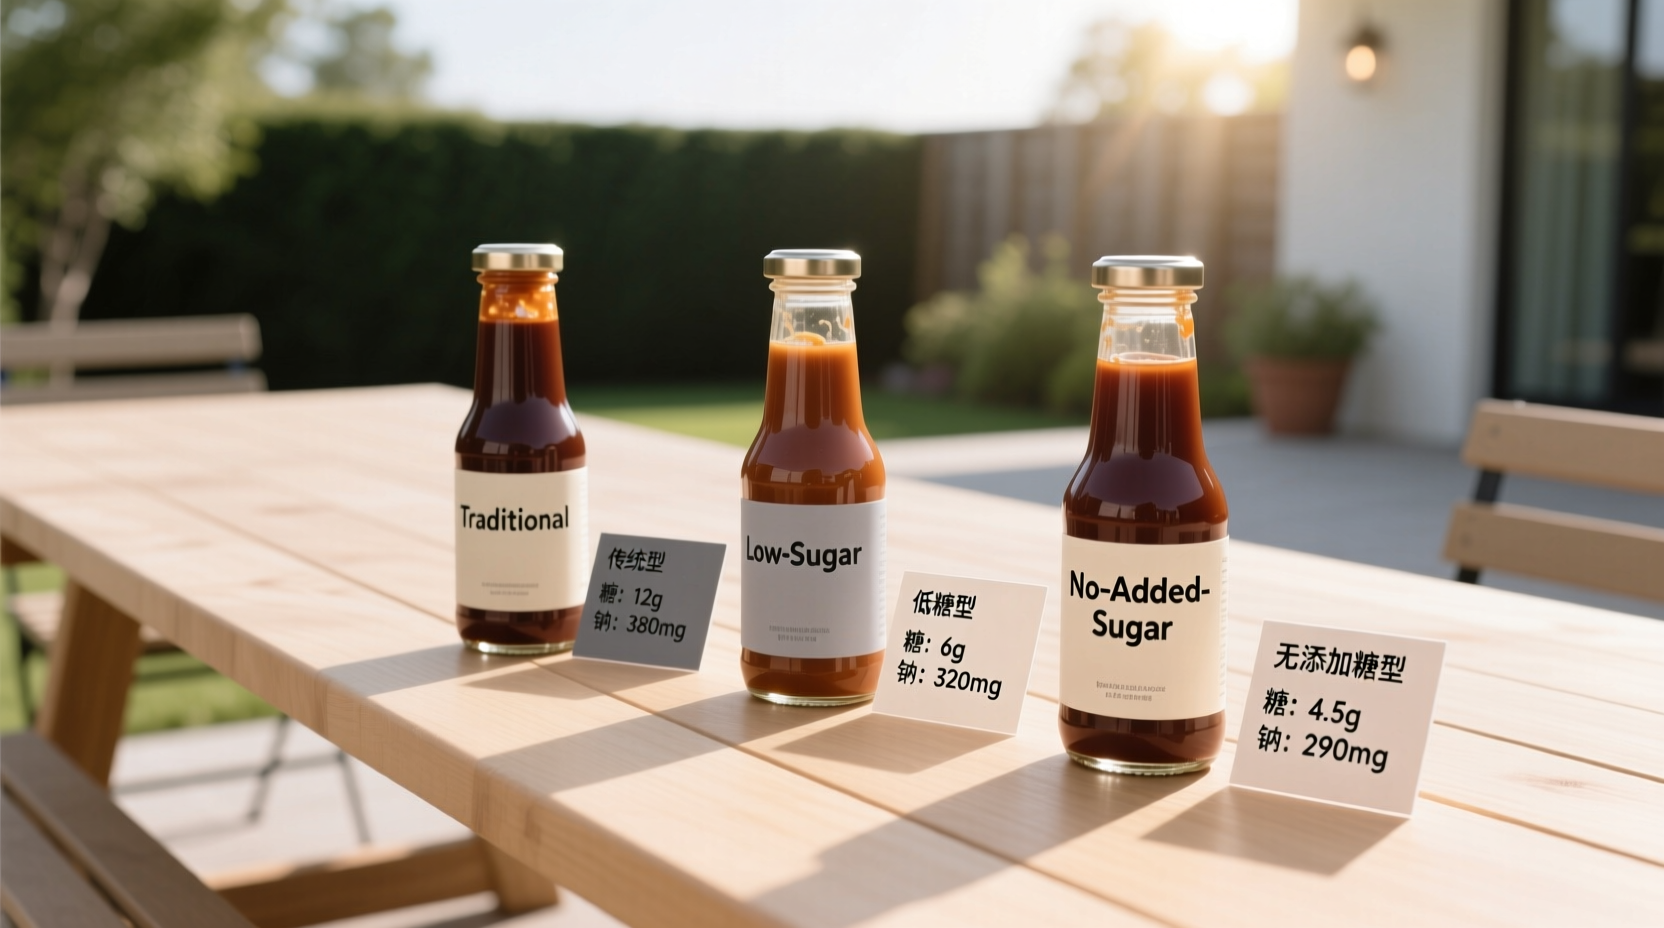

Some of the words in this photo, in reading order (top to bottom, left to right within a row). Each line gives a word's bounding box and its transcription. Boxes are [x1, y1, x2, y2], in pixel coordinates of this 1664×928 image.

[460, 504, 569, 532] Traditional
[608, 547, 666, 573] 传统型
[746, 534, 863, 573] Low-Sugar
[912, 589, 977, 619] 低糖型
[1070, 569, 1211, 604] No-Added-
[1092, 608, 1174, 647] Sugar
[1273, 642, 1407, 684] 无添加糖型
